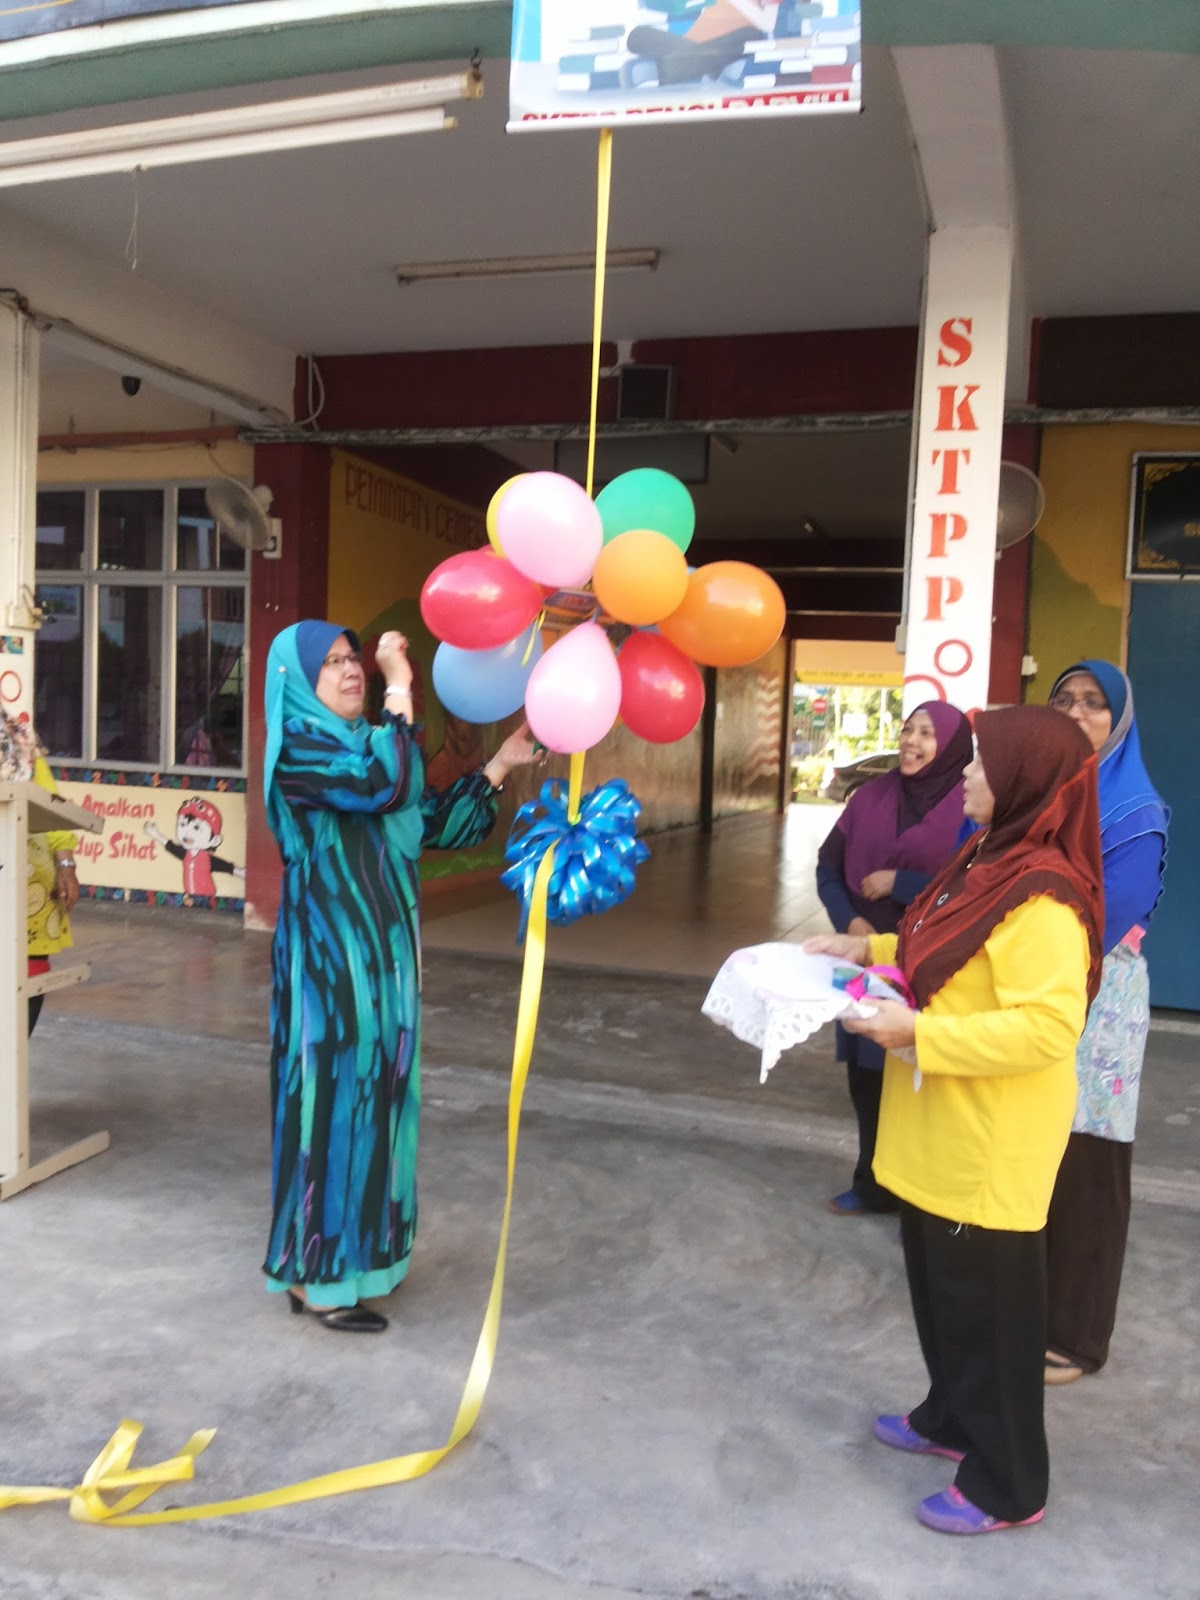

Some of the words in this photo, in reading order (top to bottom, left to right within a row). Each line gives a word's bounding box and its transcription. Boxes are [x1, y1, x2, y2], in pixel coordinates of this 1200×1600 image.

[923, 317, 981, 622] SKTPP
[82, 794, 155, 819] Amalkan
[75, 836, 105, 863] dup
[109, 831, 158, 861] Sihat
